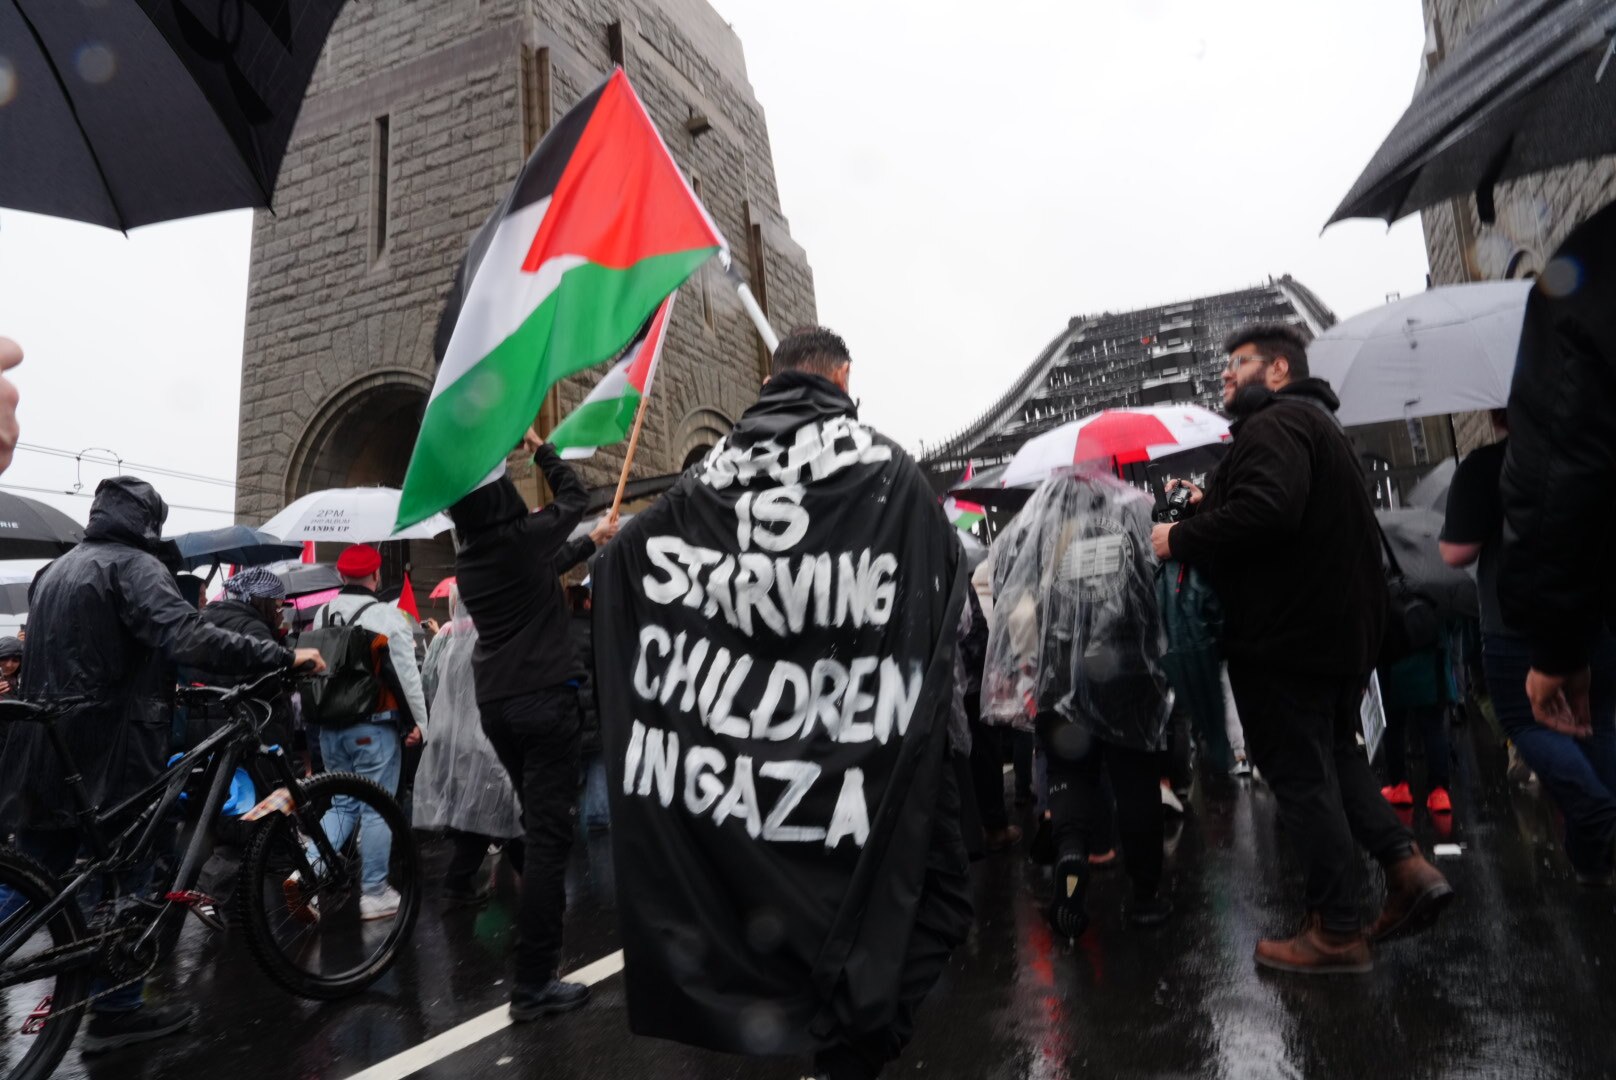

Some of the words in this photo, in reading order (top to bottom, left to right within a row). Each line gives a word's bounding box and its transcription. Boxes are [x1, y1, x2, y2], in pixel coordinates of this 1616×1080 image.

[316, 509, 344, 517] 2PM
[734, 483, 810, 552] IS
[642, 534, 898, 638] STARVING
[632, 623, 924, 747] CHILDREN
[622, 718, 680, 809] IN
[683, 745, 871, 850] GAZA
